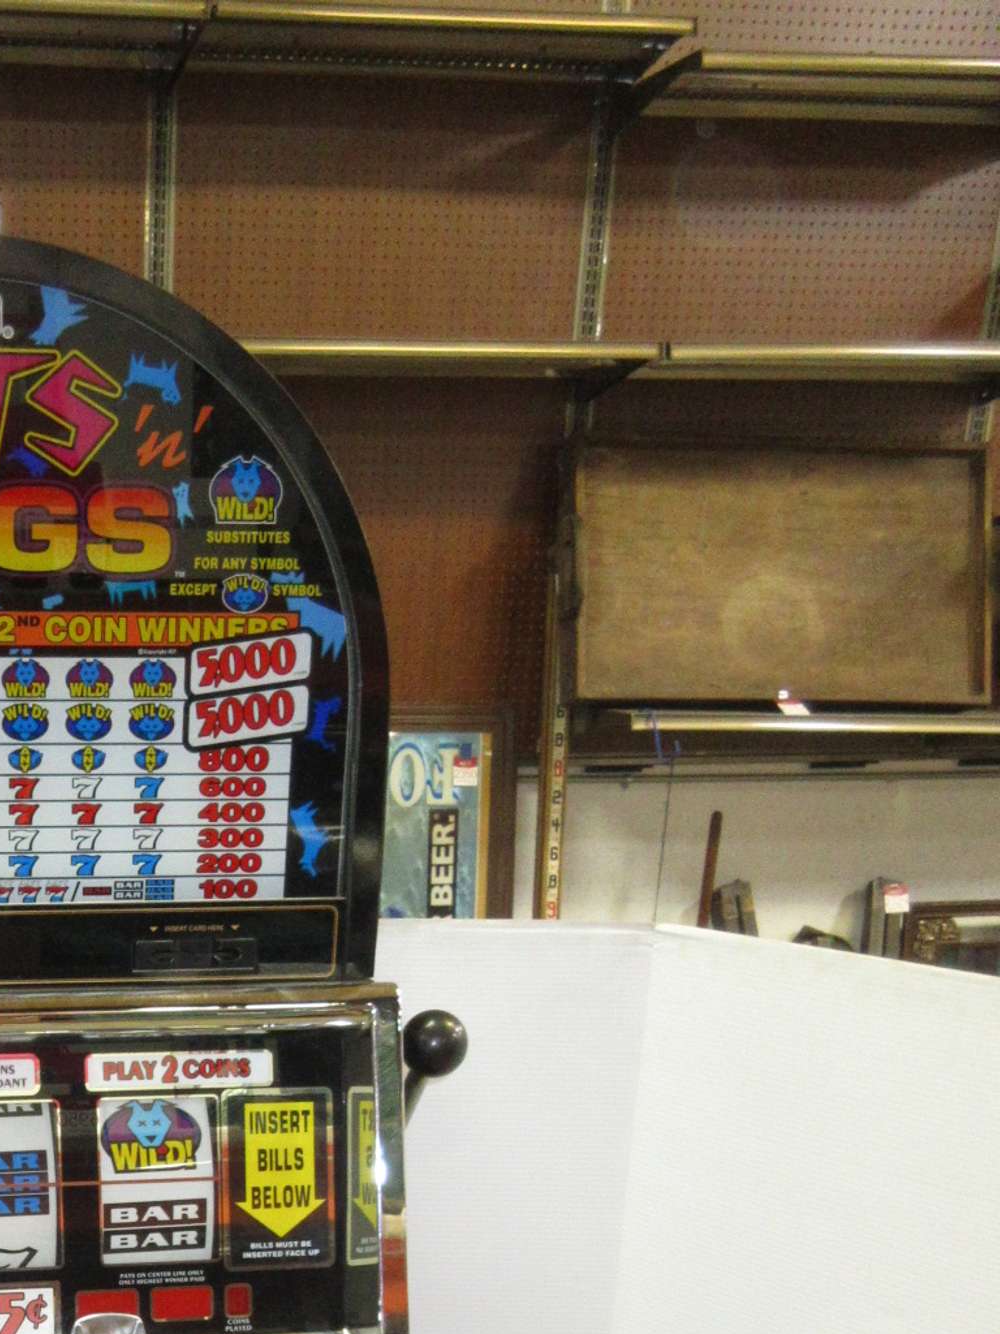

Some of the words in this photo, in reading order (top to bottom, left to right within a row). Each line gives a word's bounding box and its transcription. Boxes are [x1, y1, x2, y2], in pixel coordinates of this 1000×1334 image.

[216, 496, 277, 523] WILD!
[206, 530, 291, 545] SUBSTITUTES
[194, 557, 218, 570] FOR
[222, 557, 247, 570] ANY
[251, 556, 301, 571] SYMBOL
[170, 583, 217, 597] EXCEPT
[225, 577, 266, 593] WILD!
[273, 583, 322, 597] SYMBOL
[45, 616, 127, 644] COIN
[4, 682, 47, 698] WILD!
[68, 682, 111, 698] WILD!
[132, 682, 176, 698] WILD!
[3, 703, 48, 721] WILD!
[66, 703, 111, 721] WILD!
[129, 703, 174, 721] WILD!
[198, 746, 269, 772] 800
[198, 776, 267, 797] 600
[197, 802, 266, 823] 400
[197, 828, 265, 849] 300
[196, 853, 263, 874] 200
[198, 879, 258, 899] 100
[103, 1058, 156, 1082] PLAY
[161, 1055, 179, 1084] 2
[182, 1057, 252, 1079] COINS
[249, 1110, 311, 1134] INSERT
[110, 1141, 197, 1174] WILD!
[258, 1147, 304, 1172] BILLS
[251, 1184, 311, 1210] BELOW
[110, 1204, 200, 1225] BAR
[110, 1229, 199, 1249] BAR
[250, 1241, 274, 1250] BILLS
[276, 1240, 299, 1249] MUST
[301, 1240, 312, 1248] BE
[242, 1250, 284, 1259] INSERTED
[286, 1249, 308, 1258] FACE
[310, 1249, 320, 1257] UP
